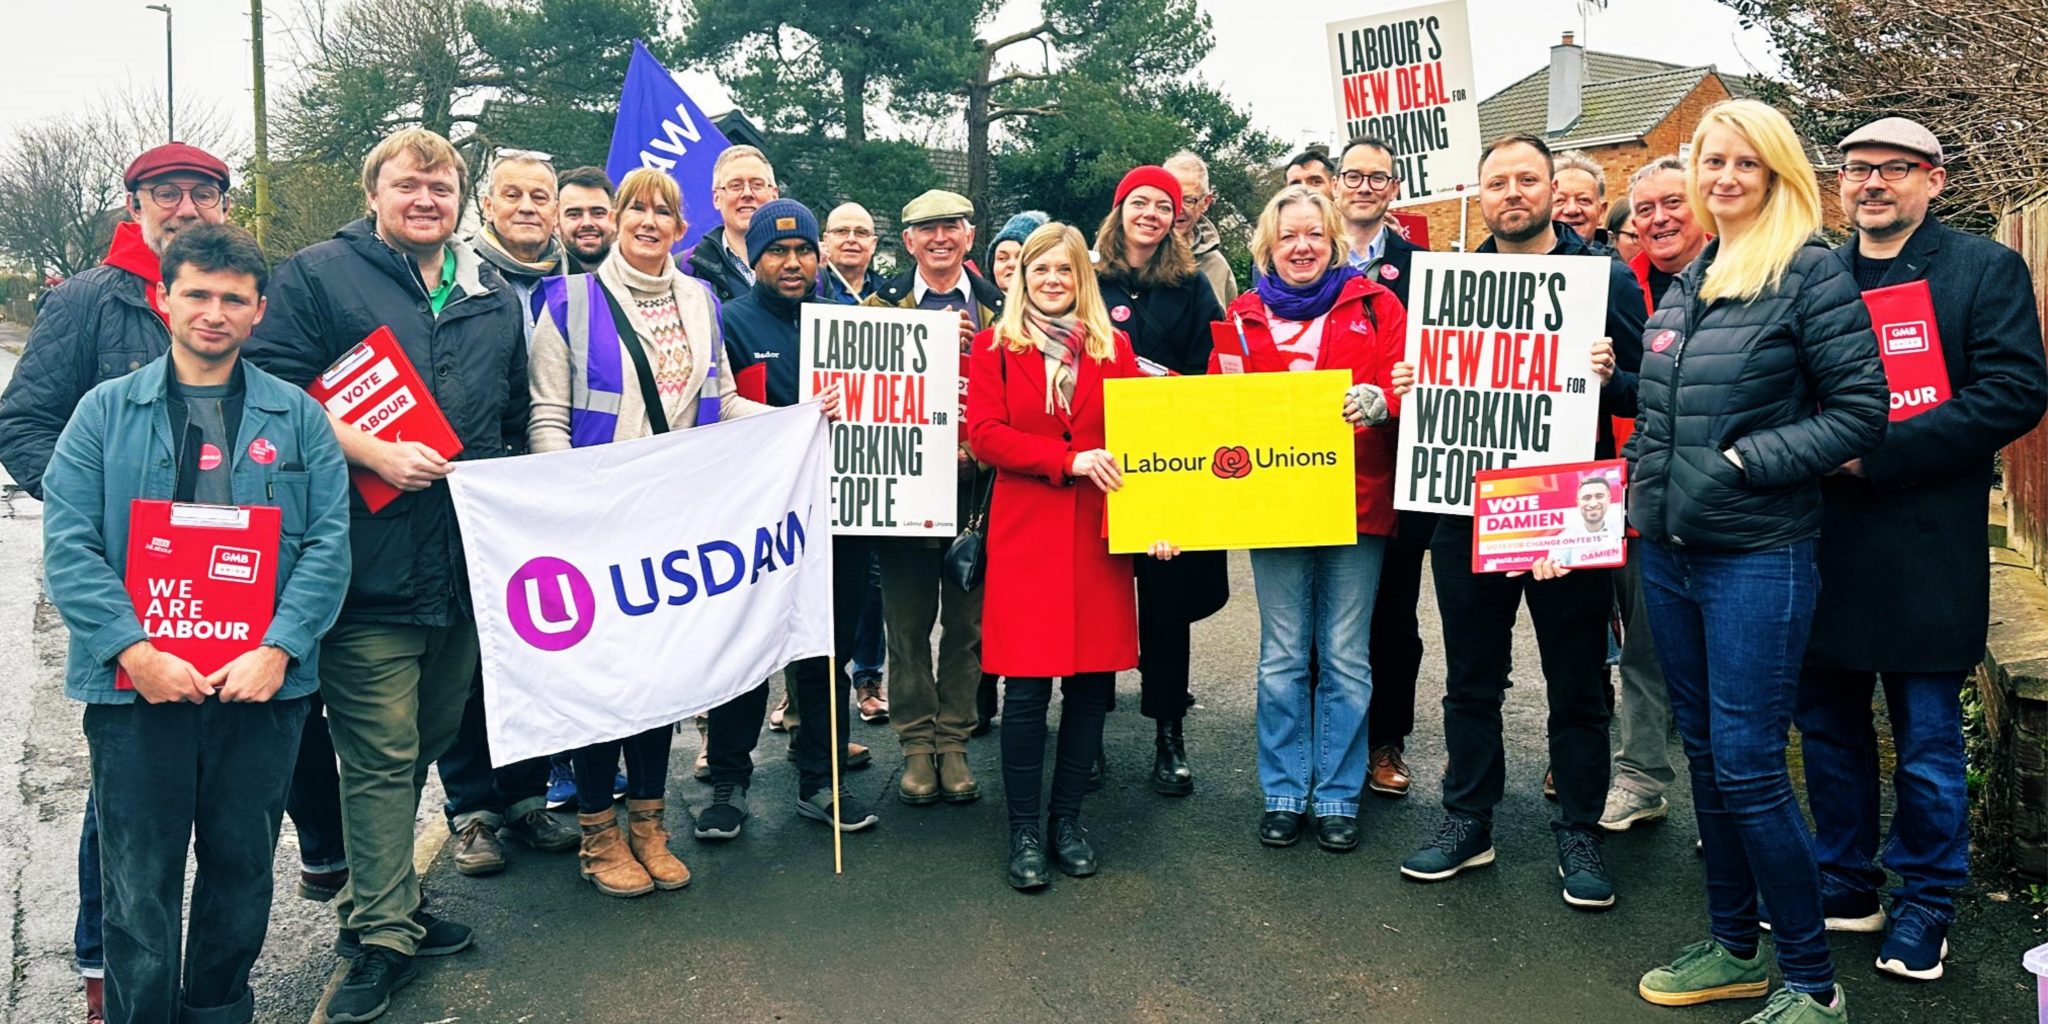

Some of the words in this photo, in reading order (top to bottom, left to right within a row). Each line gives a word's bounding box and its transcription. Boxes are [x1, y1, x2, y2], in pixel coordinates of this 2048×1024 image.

[1338, 16, 1442, 76] LABOUR'S
[1343, 71, 1389, 119] NEW
[1396, 61, 1450, 111] DEAL
[1452, 89, 1466, 102] FOR
[639, 102, 702, 173] AW
[1396, 154, 1431, 200] PLE
[1422, 268, 1566, 332] LABOUR'S
[813, 318, 928, 374] LABOUR'S
[1891, 326, 1917, 338] GMB
[1418, 328, 1484, 388] NEW
[1491, 332, 1562, 392] DEAL
[1567, 377, 1586, 394] FOR
[342, 371, 382, 404] VOTE
[873, 374, 929, 425] DEAL
[933, 412, 947, 425] FOR
[1889, 386, 1938, 409] OUR
[359, 394, 410, 432] ABOUR
[1416, 387, 1551, 452] WORKING
[829, 423, 923, 476] ORKING
[1123, 452, 1206, 473] Labour
[1255, 447, 1337, 468] Unions
[831, 476, 898, 528] EOPLE
[1486, 495, 1540, 513] VOTE
[1487, 512, 1564, 531] DAMIEN
[222, 552, 248, 564] GMB
[609, 504, 812, 616] USDAW
[1526, 539, 1561, 548] CHANGE
[1581, 548, 1619, 561] DAMIEN
[145, 598, 203, 619] ARE
[148, 578, 193, 598] WE
[524, 574, 579, 633] U
[143, 619, 249, 640] LABOUR
